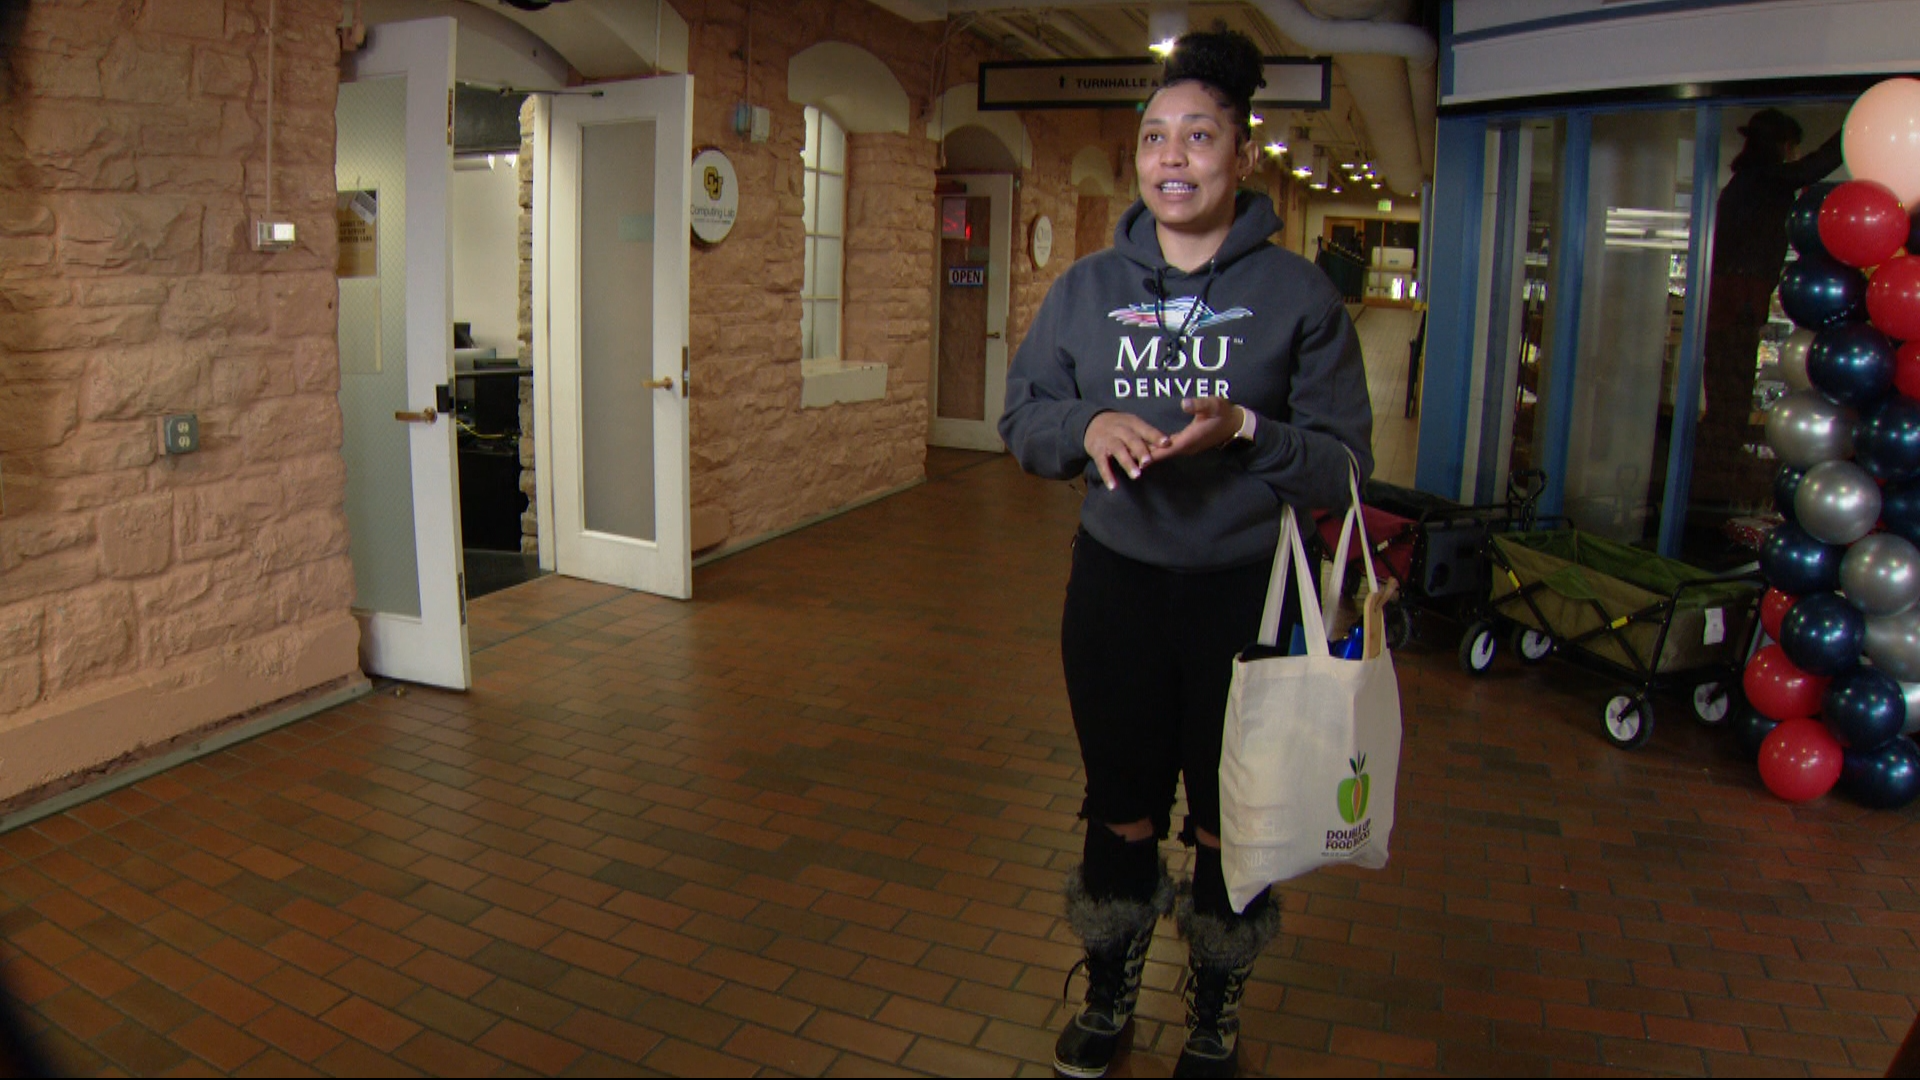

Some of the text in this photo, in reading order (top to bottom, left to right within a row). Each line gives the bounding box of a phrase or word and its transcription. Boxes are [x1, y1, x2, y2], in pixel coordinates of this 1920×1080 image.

[1076, 78, 1147, 89] TURNHALLE
[690, 204, 735, 219] Computing Lab
[951, 270, 981, 284] OPEN
[1114, 377, 1230, 399] DENVER
[1325, 839, 1352, 850] FOOD
